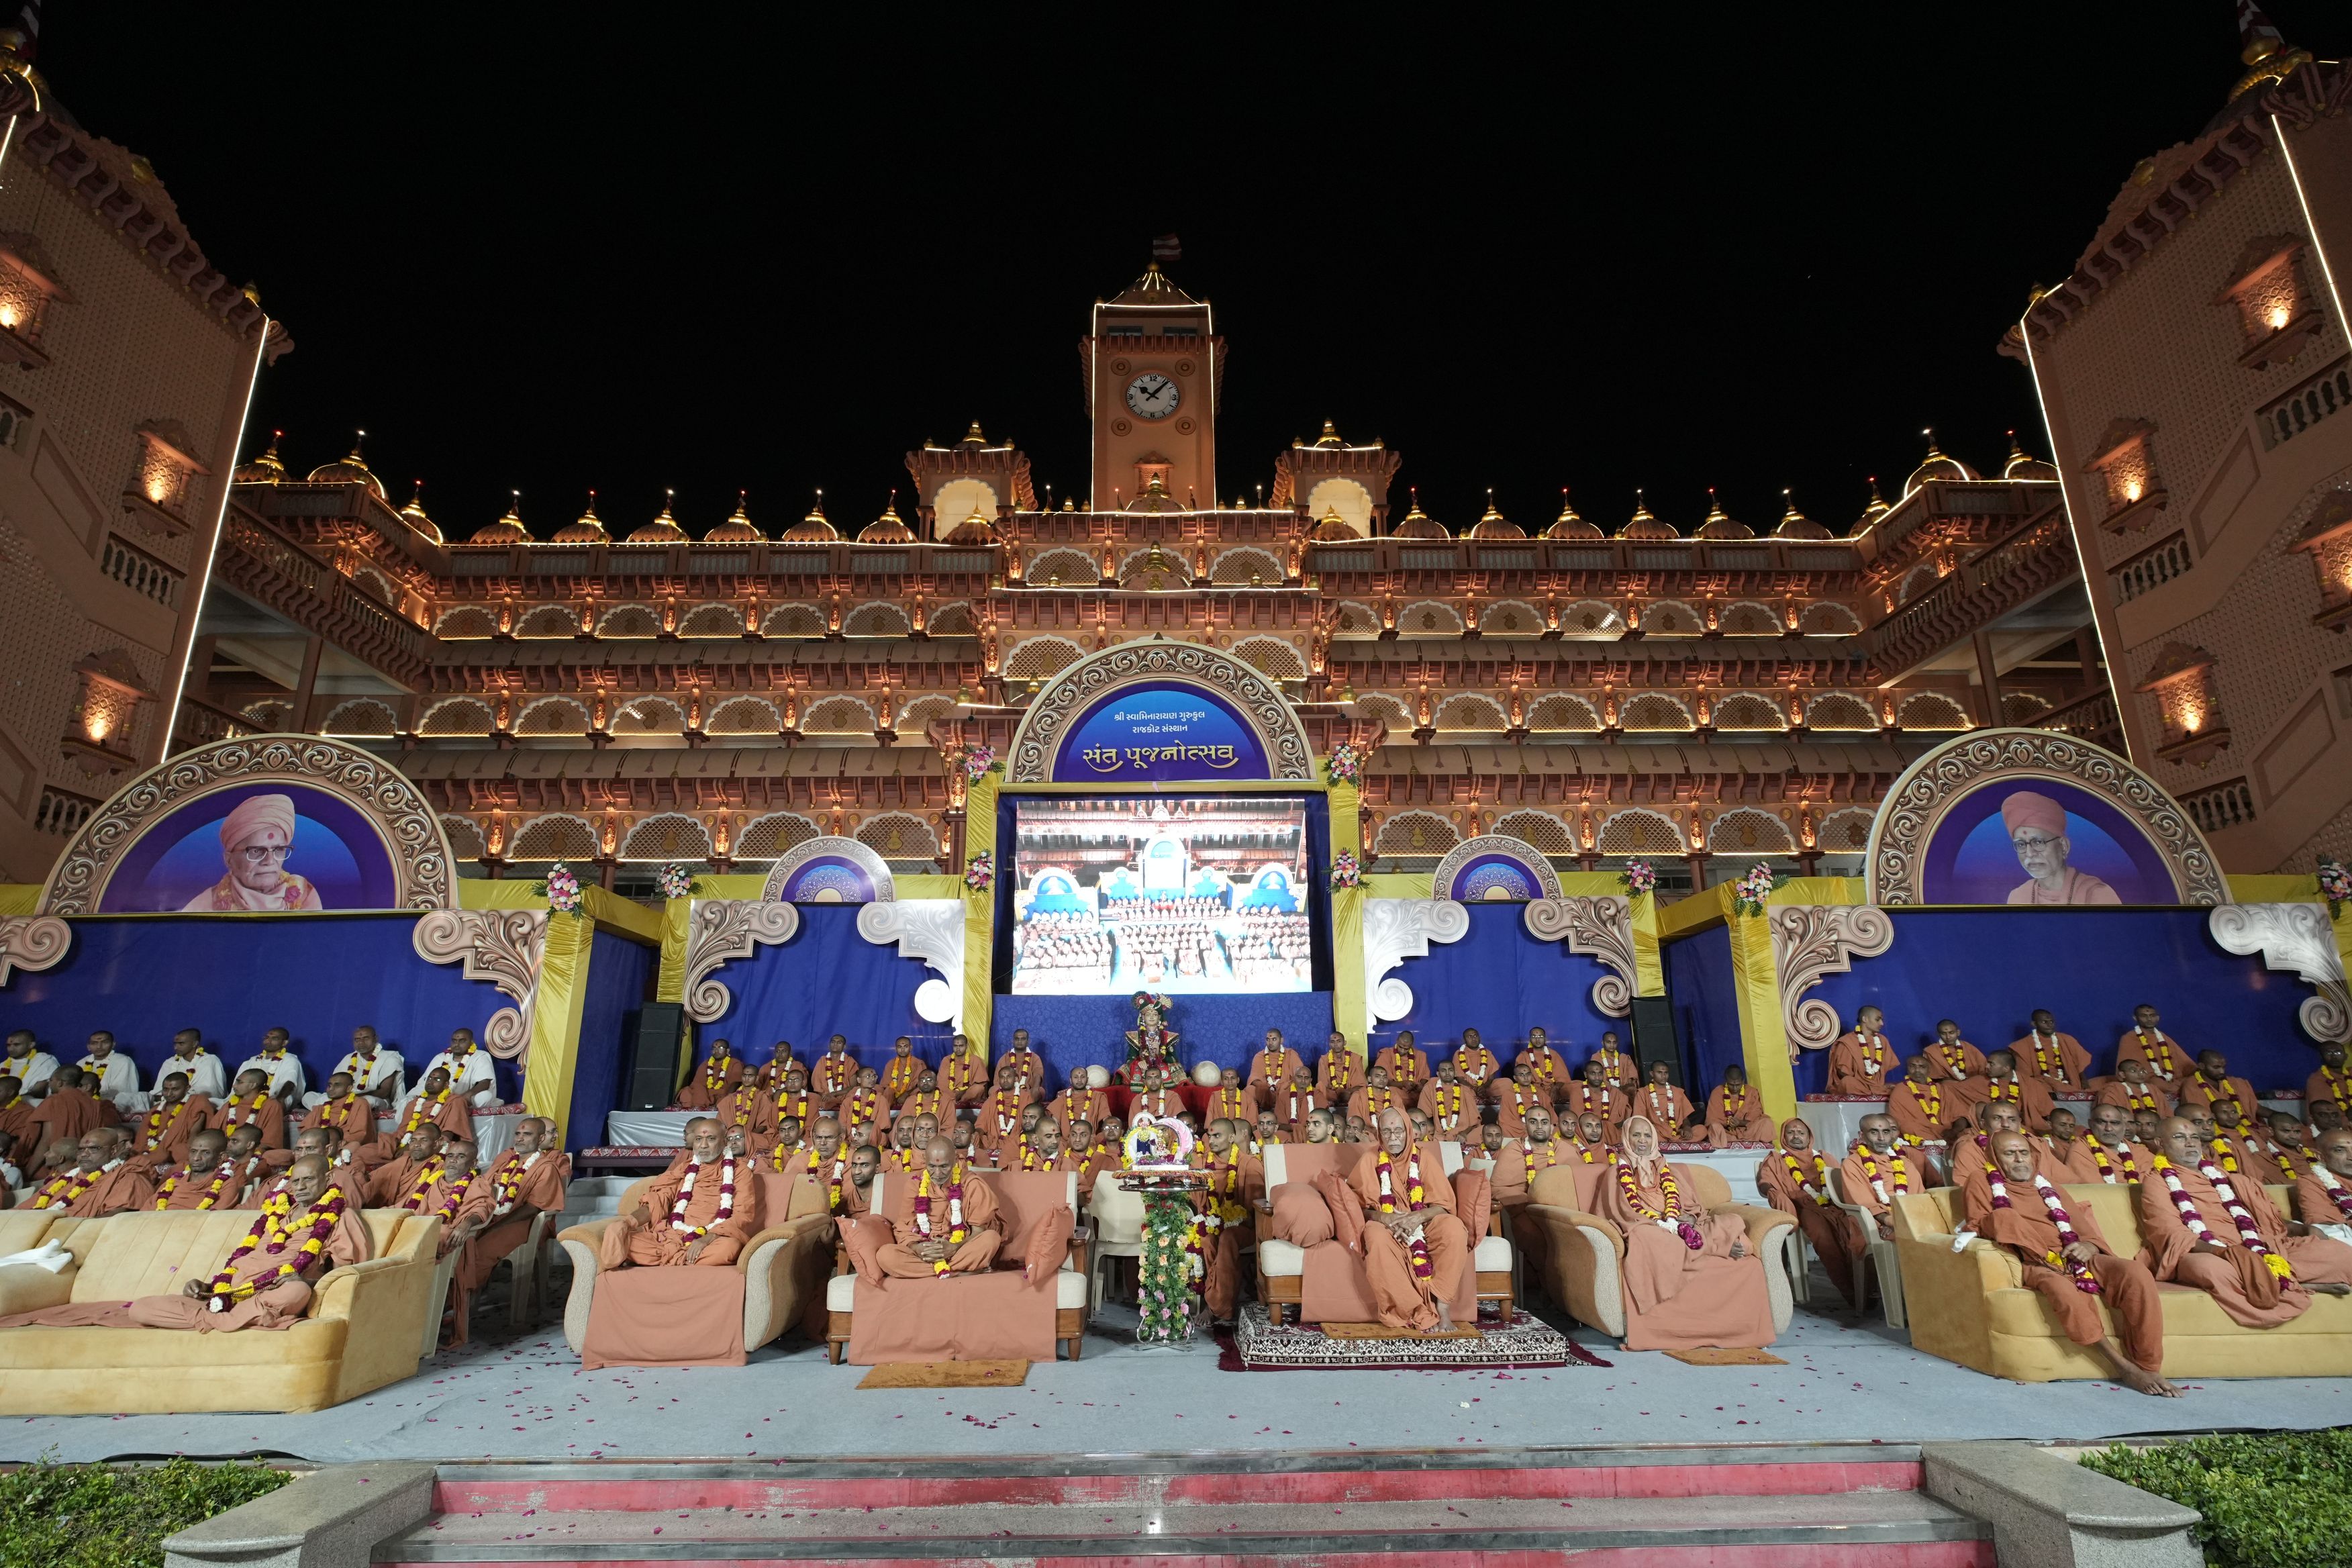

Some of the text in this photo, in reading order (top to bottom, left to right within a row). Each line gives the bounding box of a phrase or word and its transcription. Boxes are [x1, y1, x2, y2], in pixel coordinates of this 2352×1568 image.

[1114, 711, 1206, 722] શ્રી સ્વામિનારાયણ ગુરુકુલ
[1132, 724, 1188, 734] રાજકોટ સંસ્થાન
[1082, 740, 1239, 773] સંત પૂજનોત્સવ
